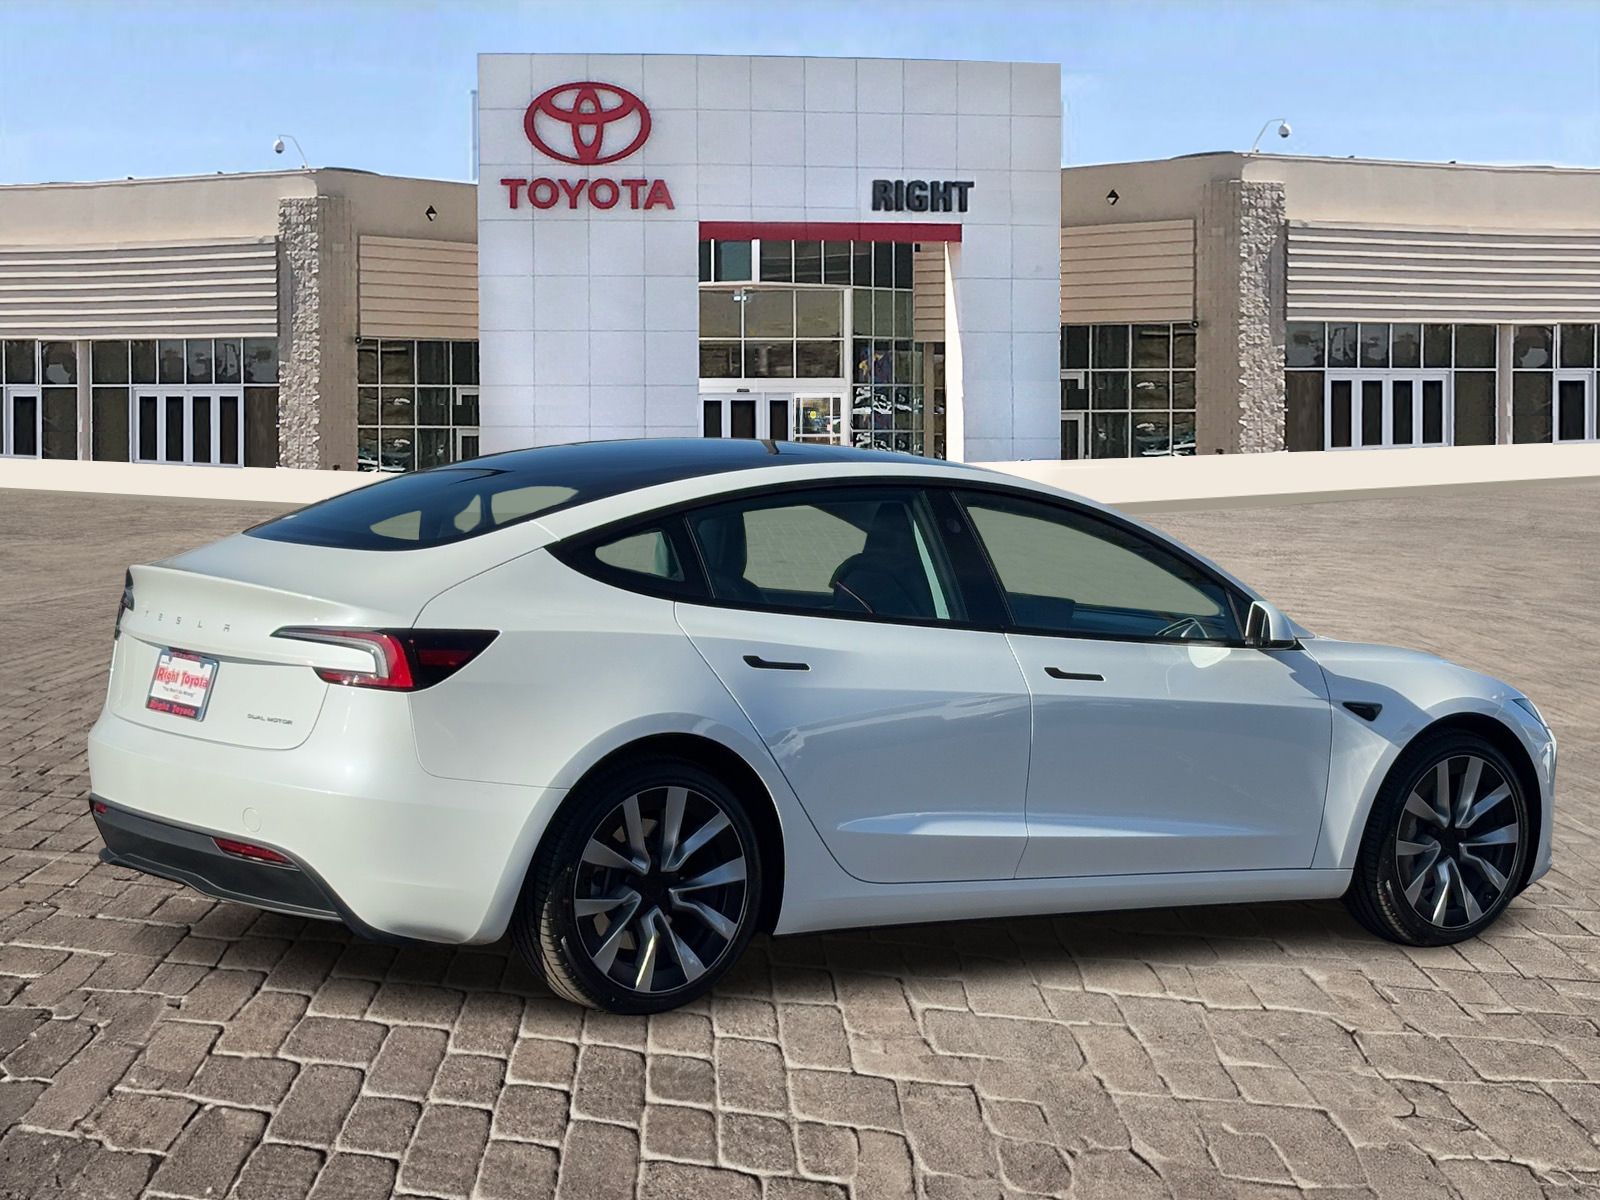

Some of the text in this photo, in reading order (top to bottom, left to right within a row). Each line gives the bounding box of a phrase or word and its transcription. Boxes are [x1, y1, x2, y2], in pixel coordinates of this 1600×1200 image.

[500, 178, 675, 209] TOYOTA
[872, 180, 974, 212] RIGHT
[144, 610, 230, 632] TESLA
[157, 667, 209, 689] Right Toyota
